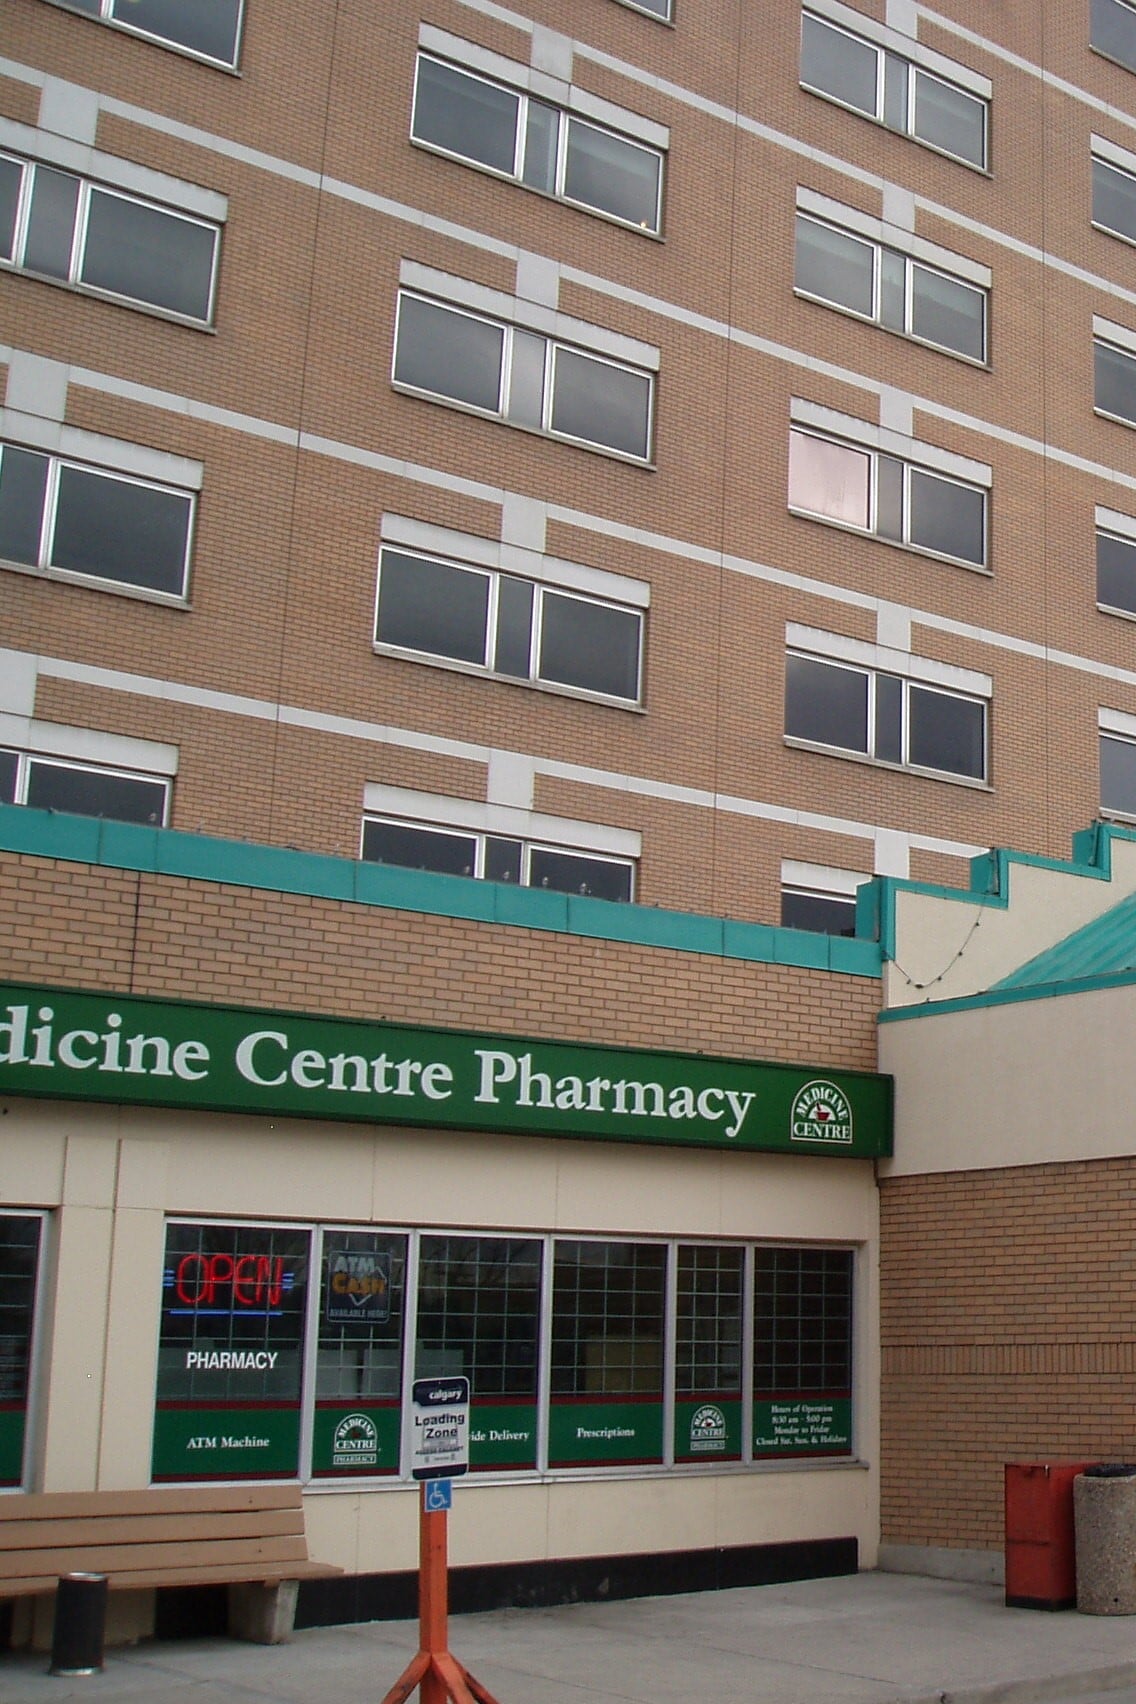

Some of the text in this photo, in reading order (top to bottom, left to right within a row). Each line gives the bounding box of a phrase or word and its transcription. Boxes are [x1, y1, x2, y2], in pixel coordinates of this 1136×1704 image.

[235, 1031, 453, 1100] Centre
[474, 1050, 756, 1138] Pharmacy
[796, 1086, 849, 1121] MEDICINE
[793, 1122, 850, 1139] CENTRE
[333, 1256, 376, 1273] ATM
[176, 1254, 284, 1306] OPEN
[186, 1351, 278, 1370] PHARMACY
[428, 1389, 462, 1401] calgary
[771, 1404, 833, 1413] Hours of Operation
[415, 1413, 465, 1426] Loading
[339, 1417, 375, 1439] MEDICINE
[426, 1427, 458, 1439] Zone
[576, 1426, 635, 1440] Prescriptions
[186, 1436, 270, 1449] ATM Machine
[468, 1430, 530, 1442] ide Delivery
[335, 1440, 376, 1450] CENTRE
